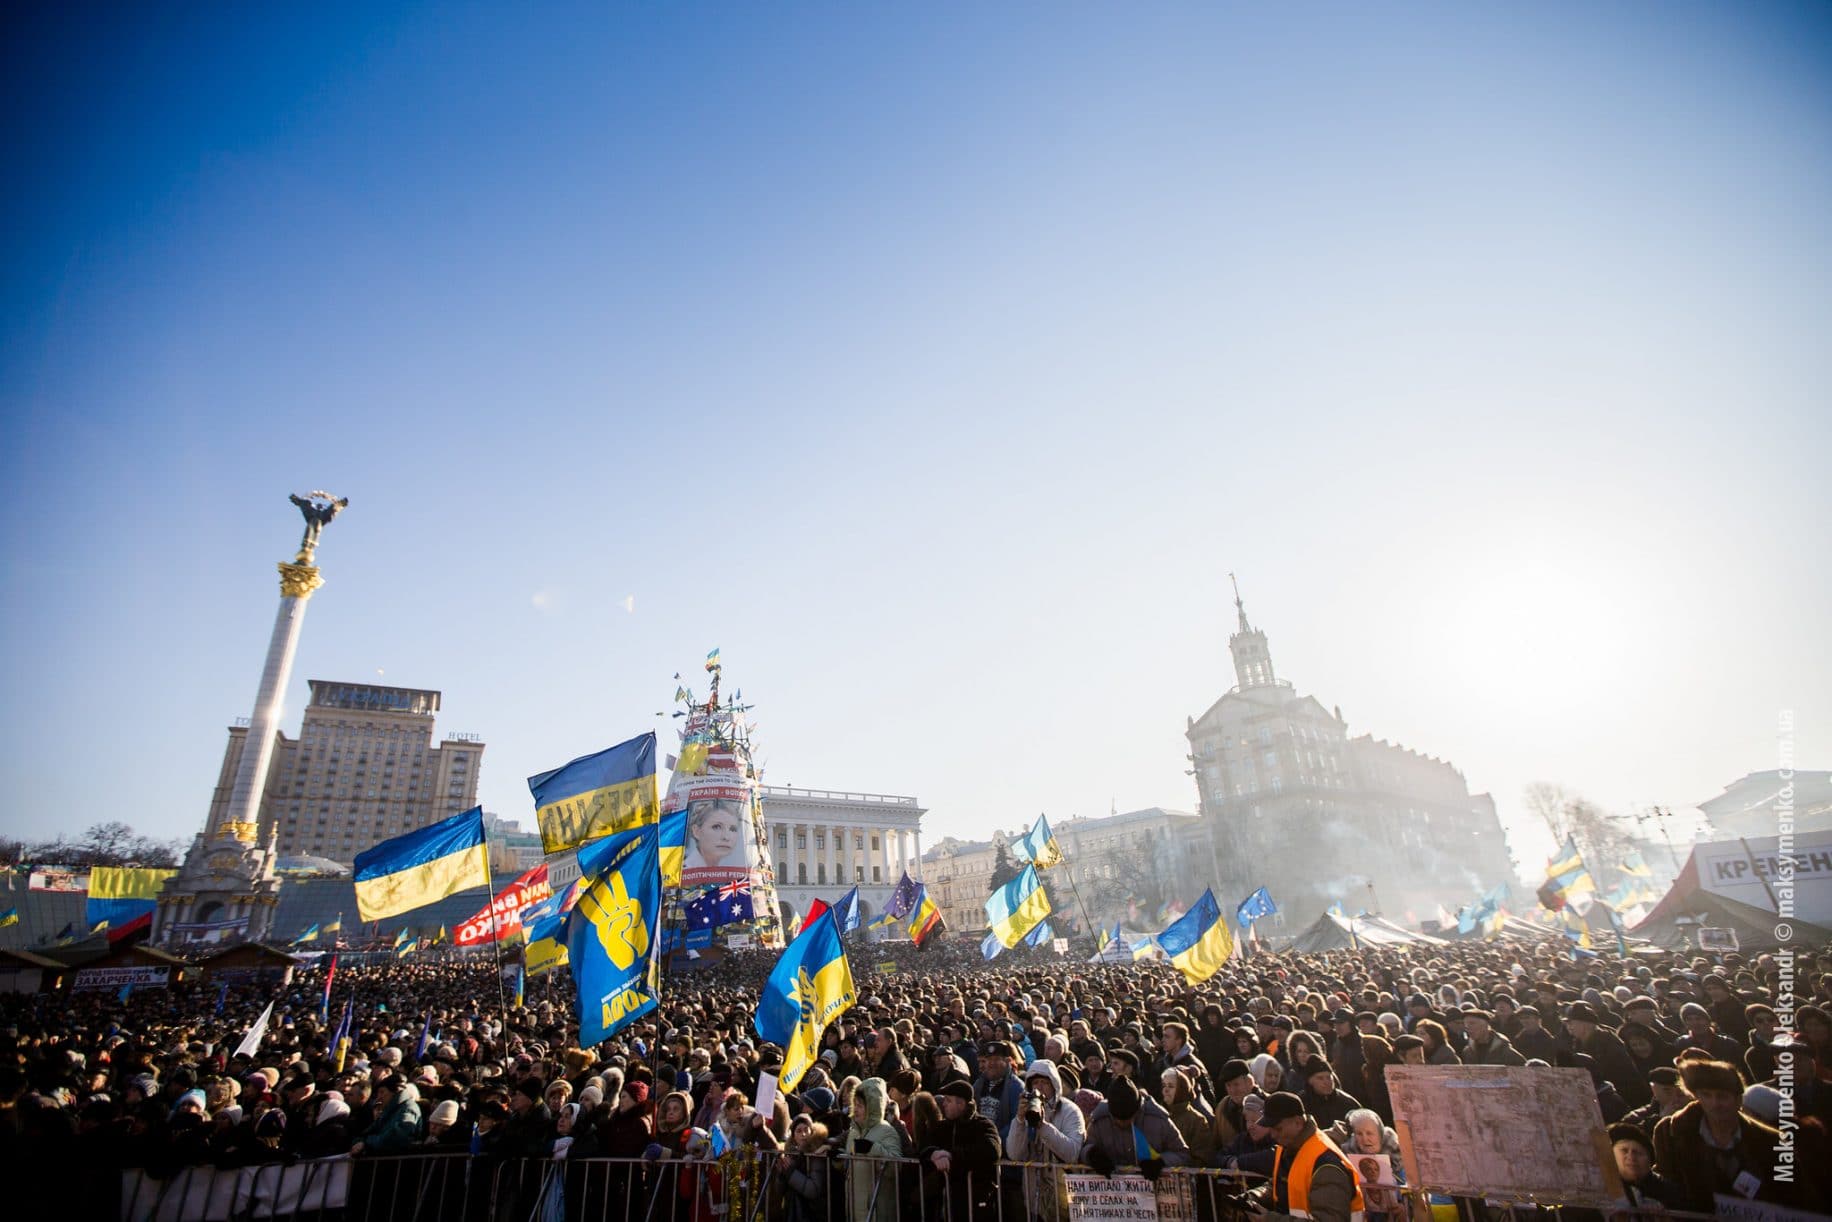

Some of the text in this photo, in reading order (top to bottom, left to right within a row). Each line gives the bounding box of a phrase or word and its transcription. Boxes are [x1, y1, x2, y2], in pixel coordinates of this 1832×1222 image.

[448, 731, 480, 741] HOTEL
[1067, 1181, 1085, 1193] НАМ
[1093, 1196, 1098, 1206] В
[1100, 1196, 1124, 1206] СЕЛАХ
[1127, 1196, 1138, 1206] НА
